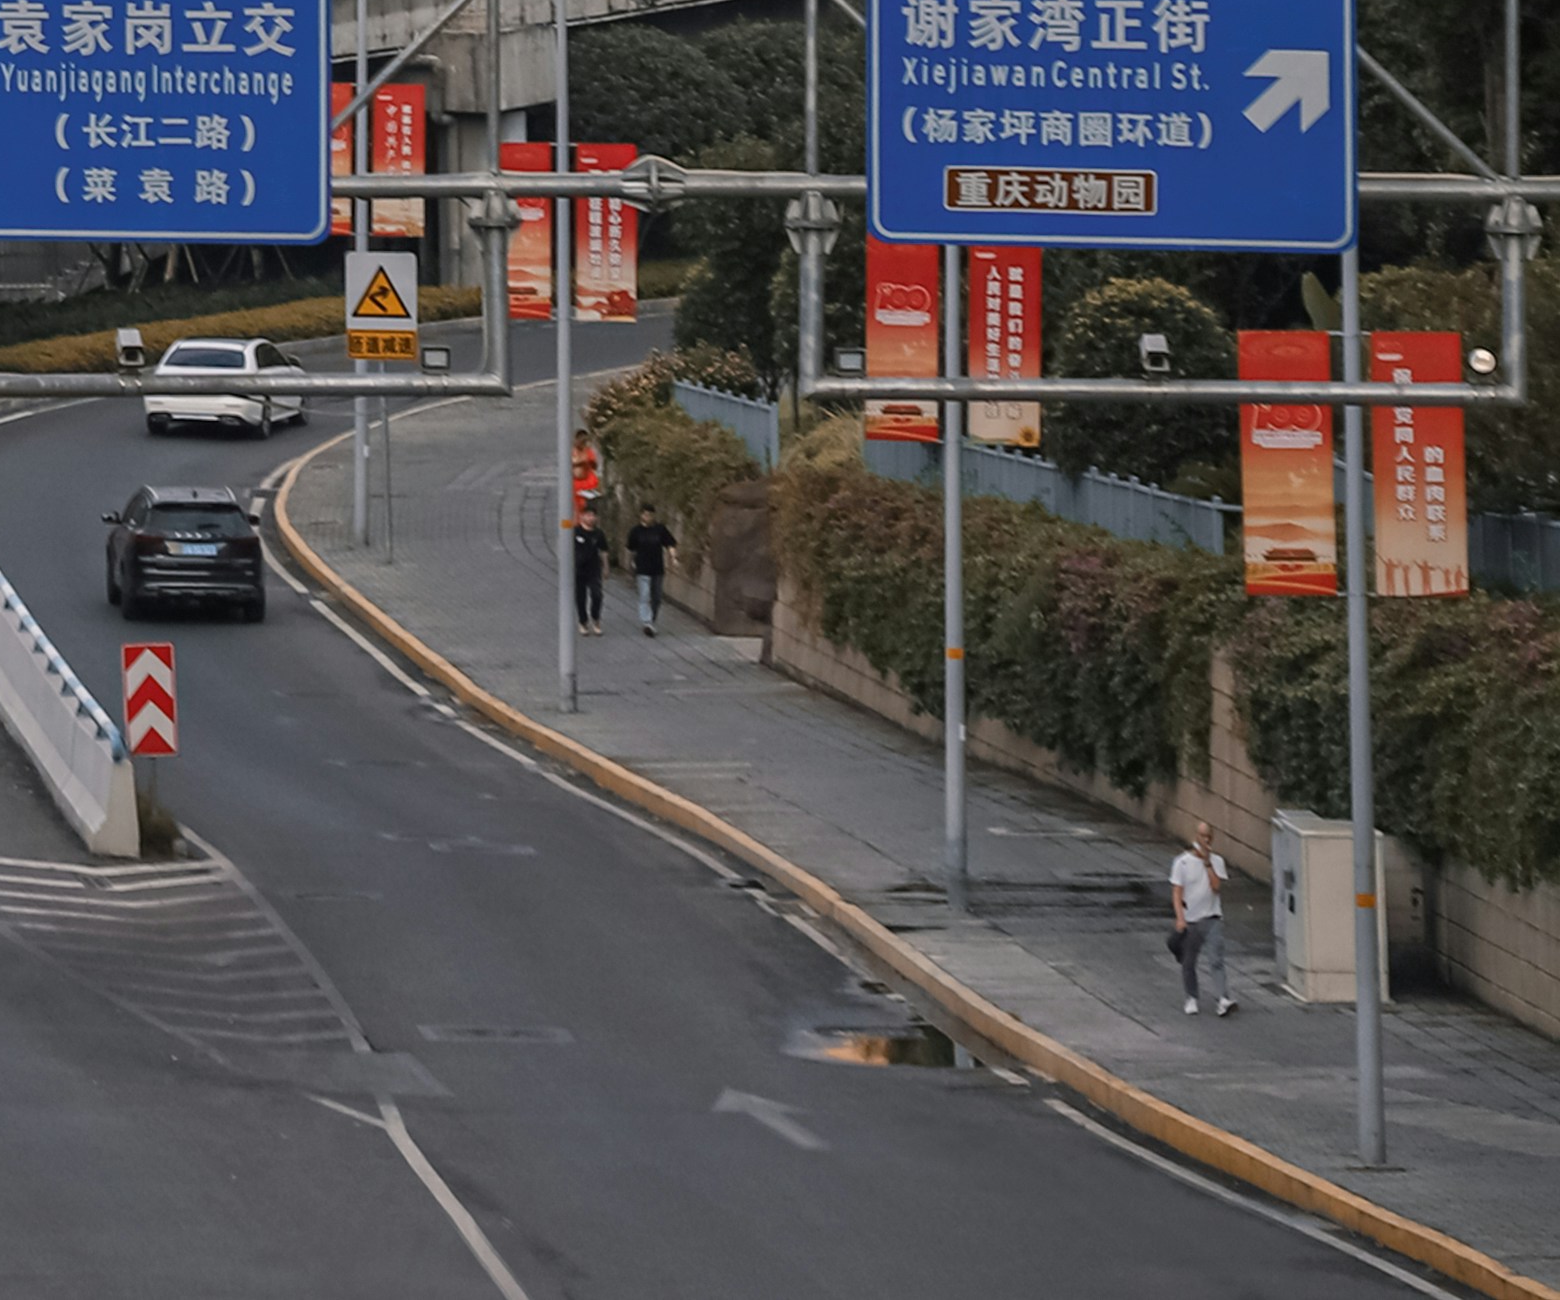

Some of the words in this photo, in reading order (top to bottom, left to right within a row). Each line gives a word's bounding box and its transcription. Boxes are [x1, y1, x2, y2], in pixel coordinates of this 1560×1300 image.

[0, 62, 146, 103] Yuanjiagang
[152, 64, 293, 105] Interchange
[902, 57, 1045, 94] Xiejiawan
[1052, 60, 1161, 91] Central
[1171, 61, 1211, 92] St.
[55, 113, 255, 152] (长江二路)
[902, 106, 1212, 150] (杨家坪商圈环道)
[956, 172, 1145, 212] 重庆动物园
[1392, 368, 1416, 520] 保党同人民群众
[1424, 446, 1446, 542] 的血肉联系
